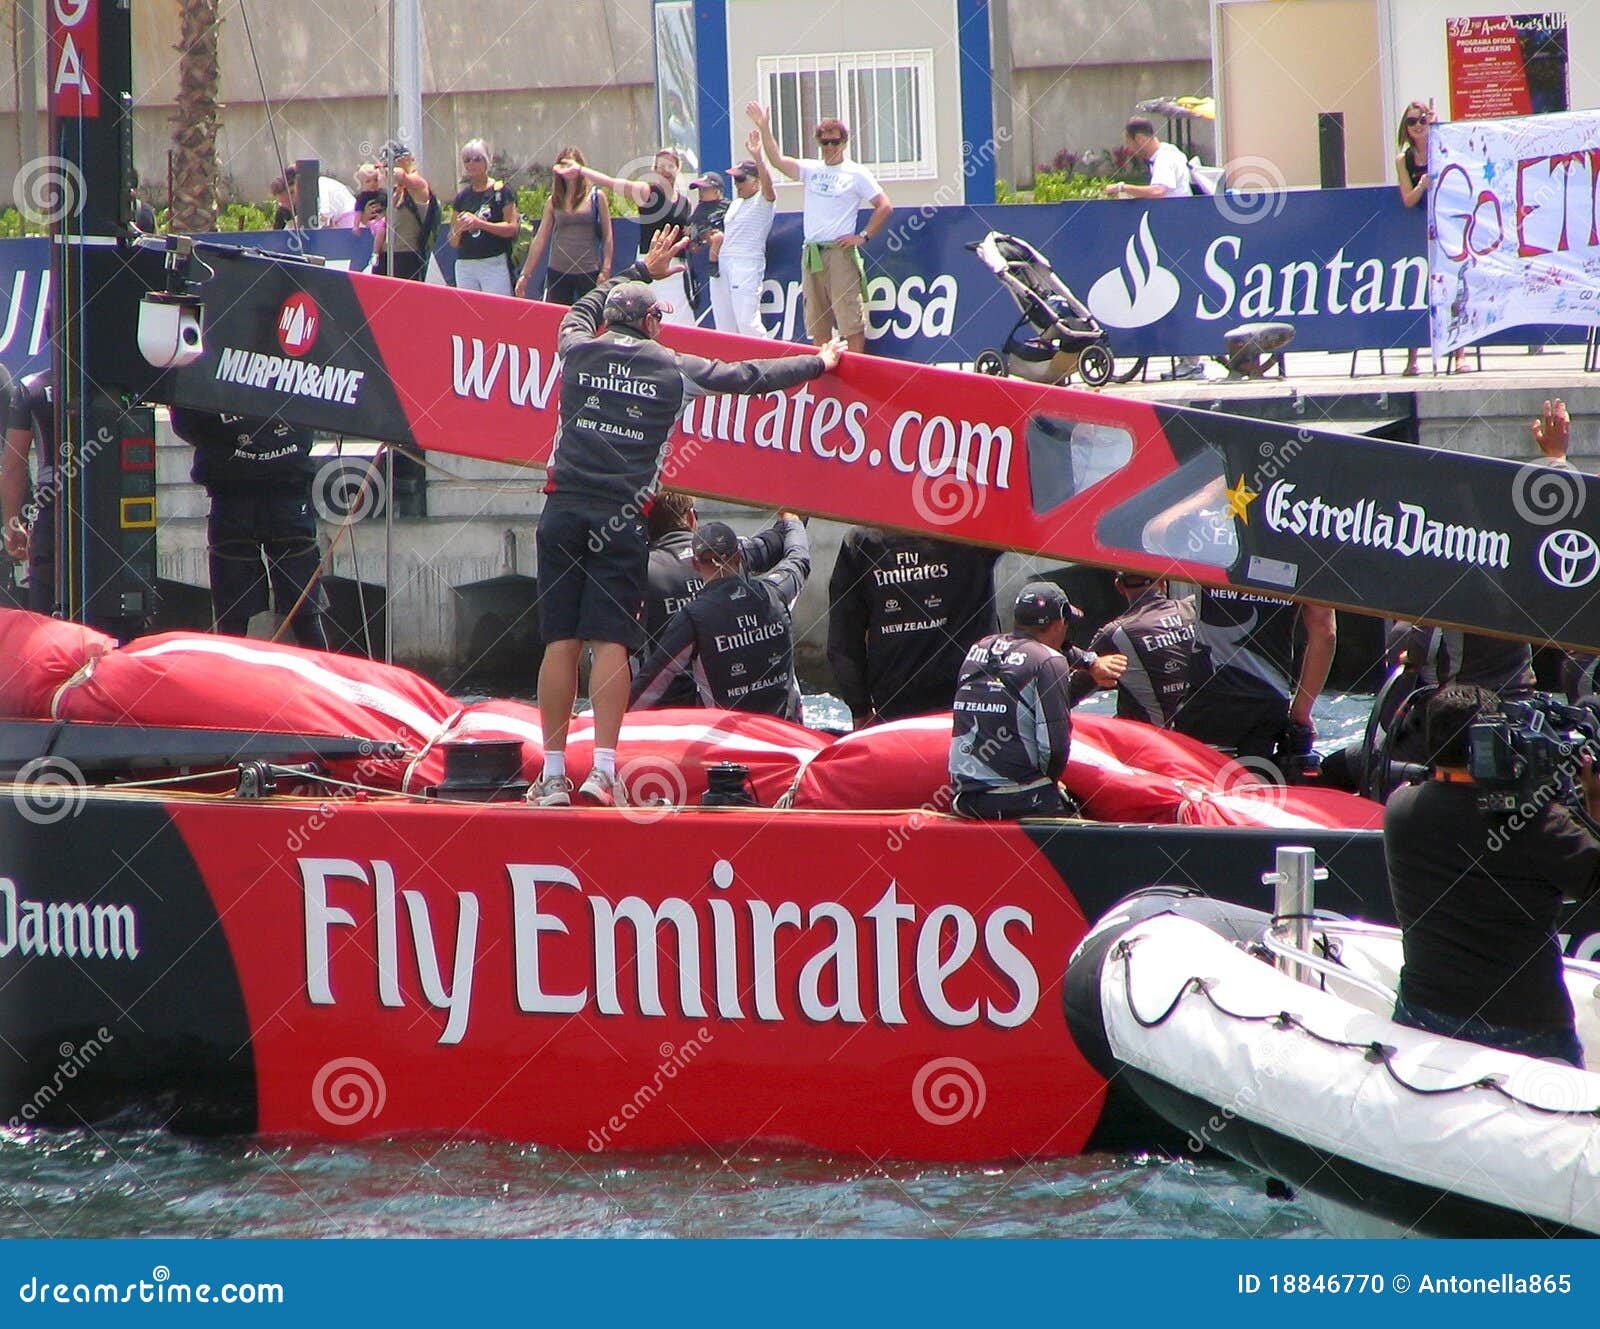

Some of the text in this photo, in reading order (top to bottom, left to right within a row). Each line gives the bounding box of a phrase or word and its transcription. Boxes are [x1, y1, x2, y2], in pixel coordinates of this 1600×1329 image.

[216, 347, 365, 405] MURPHY&NYE
[608, 362, 631, 378] Fly
[578, 372, 657, 399] Emirates
[576, 418, 645, 441] NEW ZEALAND
[234, 443, 299, 461] NEW ZEALAND
[896, 552, 919, 565] Fly
[873, 563, 949, 587] Emirates
[1210, 588, 1239, 600] NEW
[736, 614, 758, 629] Fly
[881, 617, 948, 635] NEW ZEALAND
[714, 620, 784, 653] Emirates
[727, 685, 749, 698] NEW
[751, 672, 789, 692] ZEALAND
[1162, 682, 1184, 694] NEW
[953, 701, 1007, 713] EW ZEALAND
[297, 857, 1041, 1045] Fly Emirates
